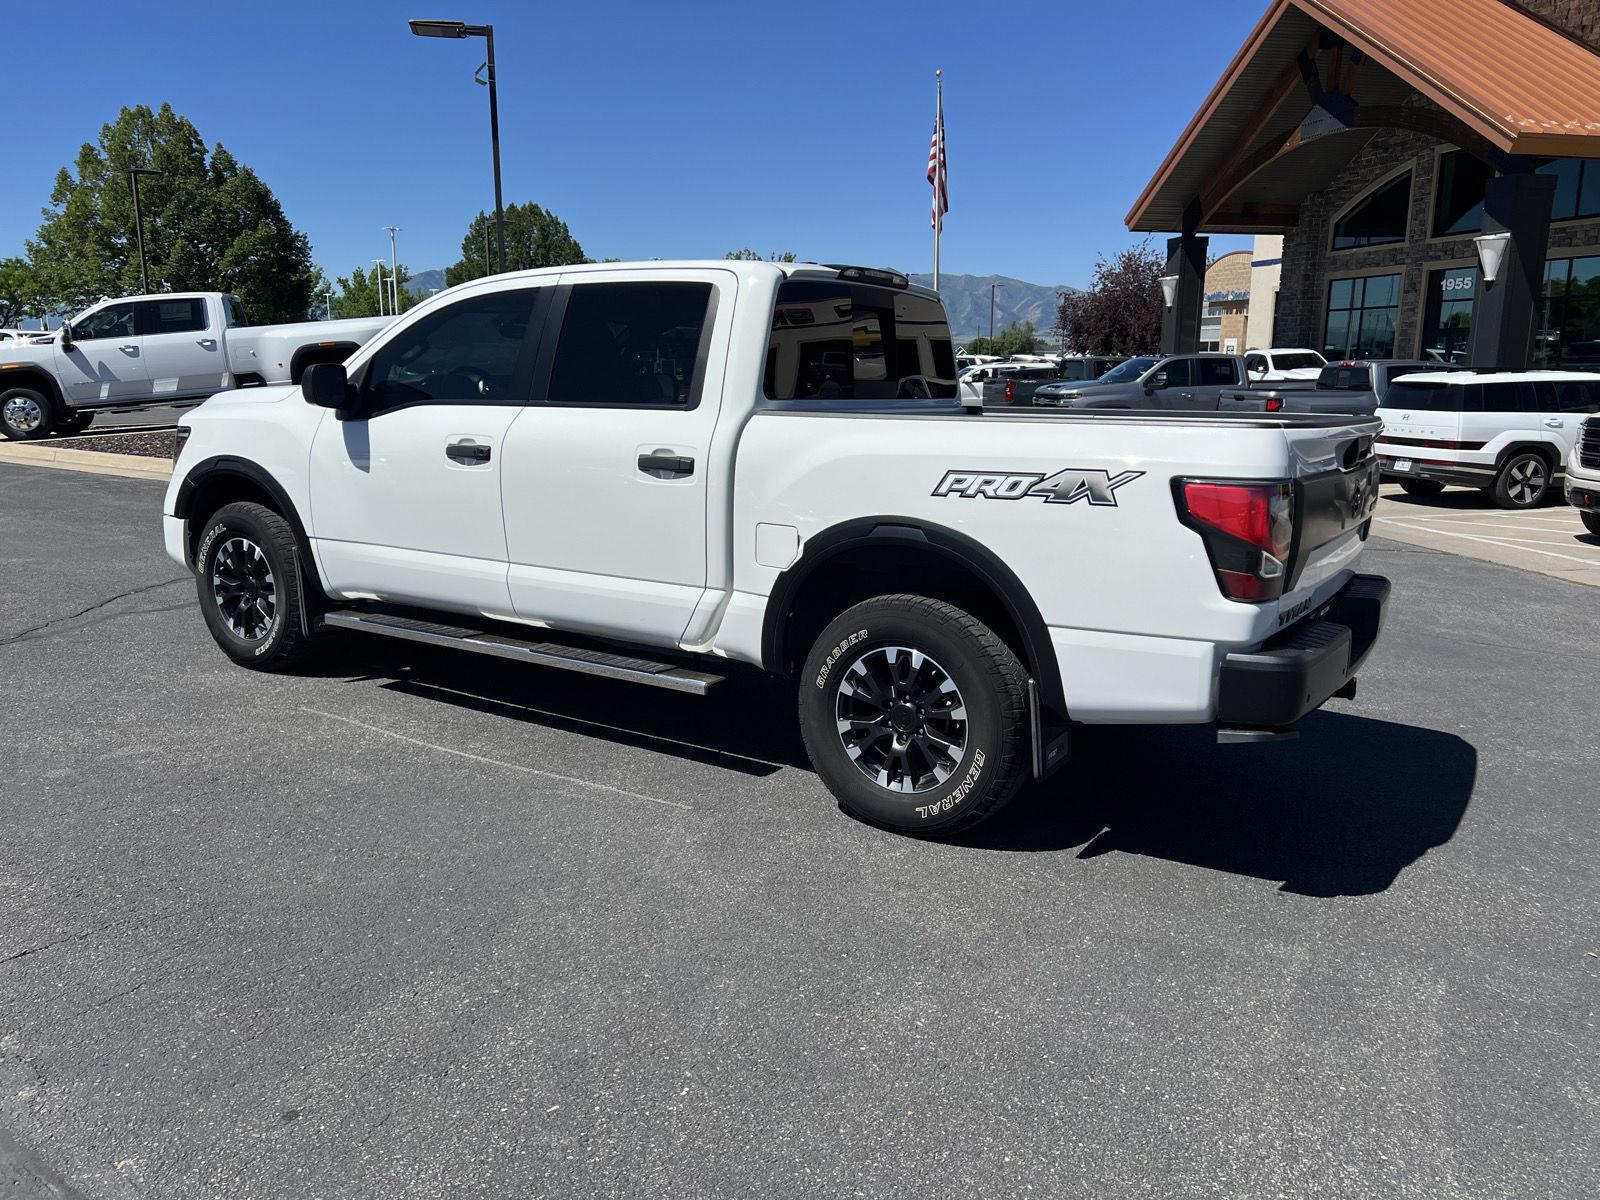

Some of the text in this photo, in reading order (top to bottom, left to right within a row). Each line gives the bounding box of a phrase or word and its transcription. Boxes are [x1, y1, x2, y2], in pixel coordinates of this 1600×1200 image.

[1440, 276, 1473, 291] 1955
[198, 523, 227, 574] GENERAL
[815, 629, 868, 689] GRABBER
[915, 748, 986, 819] GENERAL
